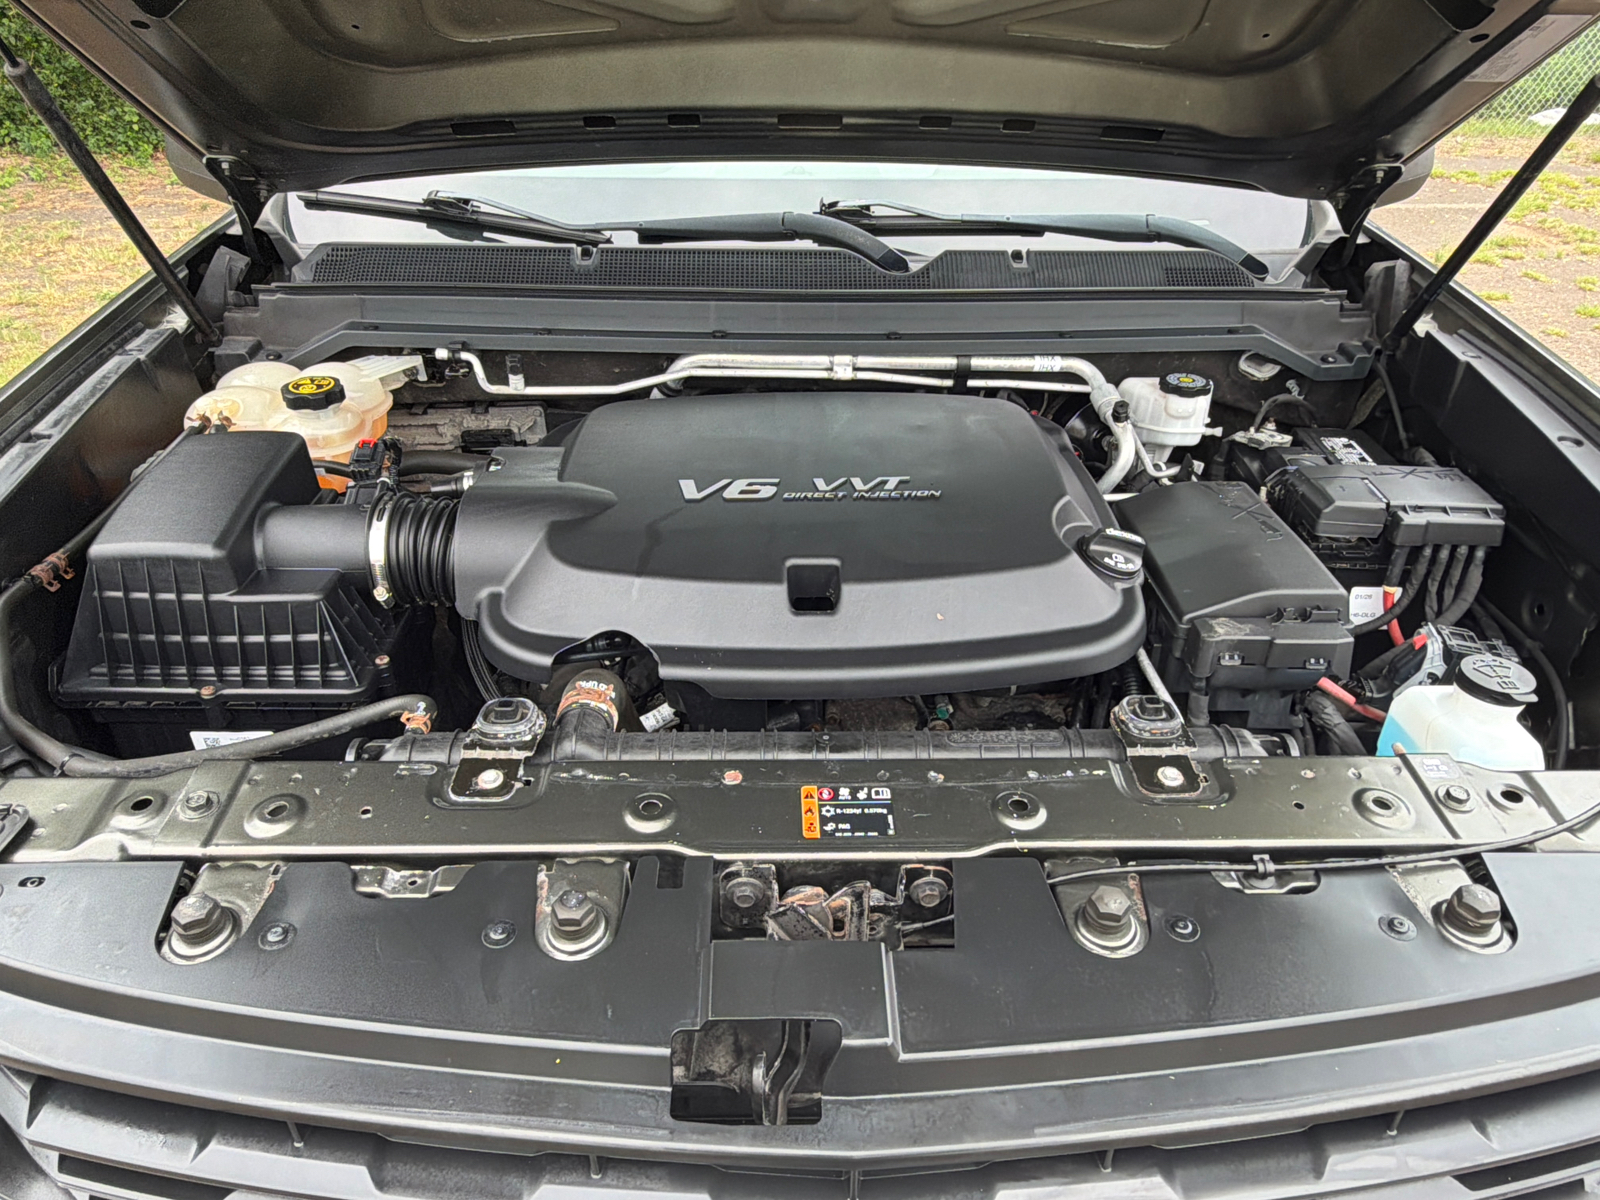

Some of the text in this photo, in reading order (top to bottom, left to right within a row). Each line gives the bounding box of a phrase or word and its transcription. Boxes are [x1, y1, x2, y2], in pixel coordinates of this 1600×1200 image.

[678, 475, 911, 500] V6 VVT
[782, 489, 942, 500] DIRECT INJECTION
